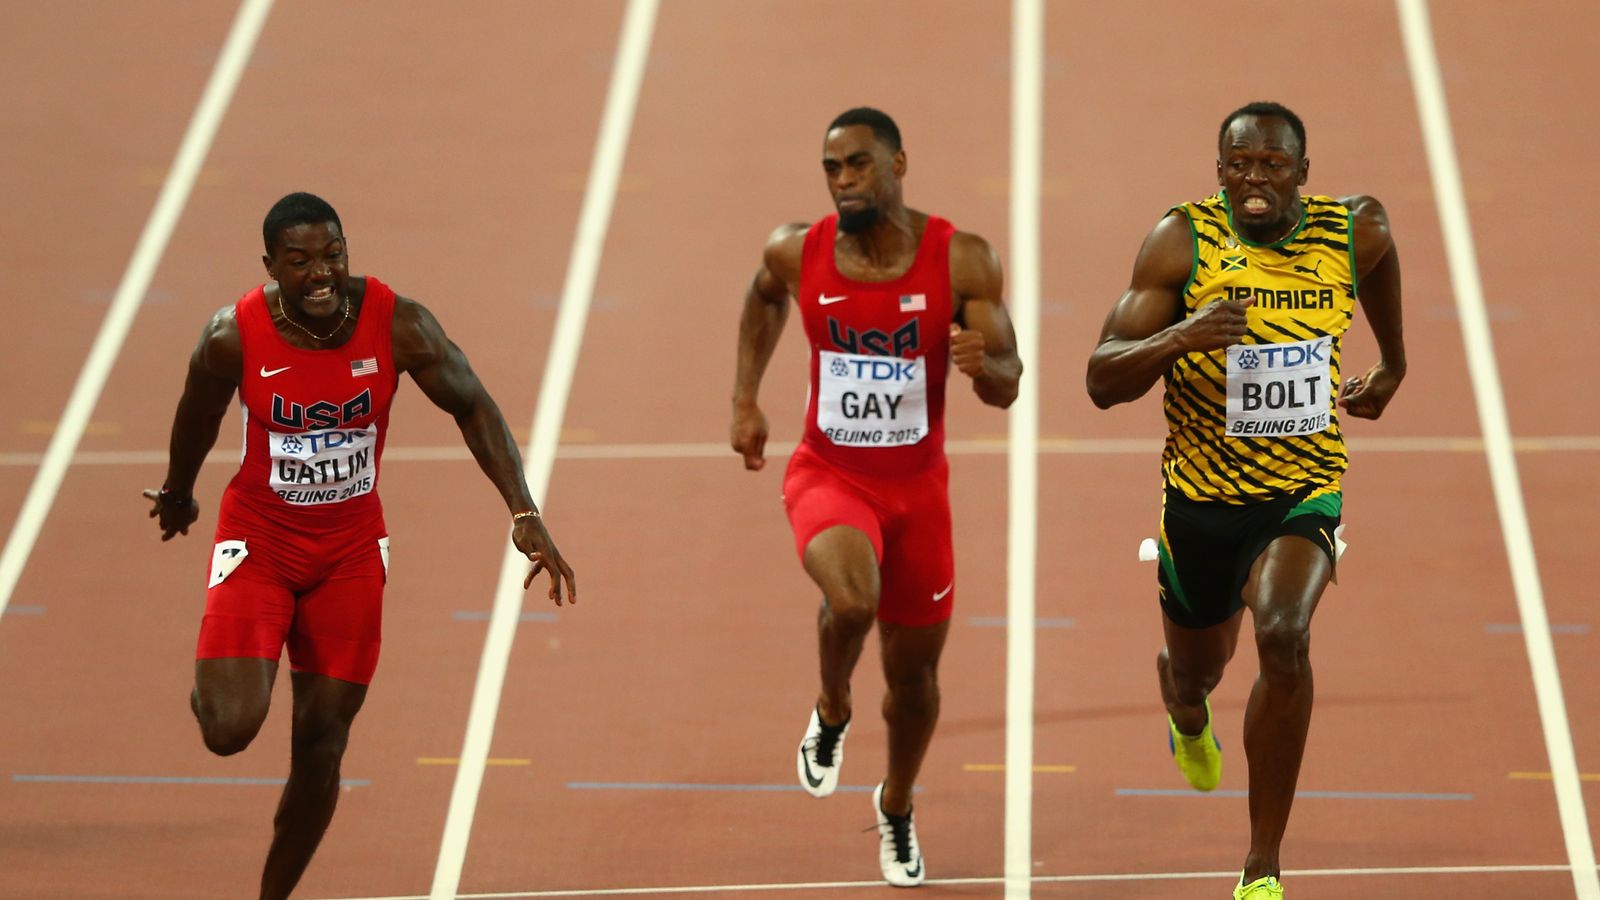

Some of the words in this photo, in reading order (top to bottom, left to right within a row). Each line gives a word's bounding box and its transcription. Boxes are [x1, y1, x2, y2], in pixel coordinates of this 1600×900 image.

[828, 315, 920, 358] USA
[1260, 341, 1324, 367] TDK
[849, 360, 916, 380] TDK
[841, 391, 904, 420] GAY
[1242, 375, 1321, 411] BOLT
[272, 388, 371, 430] USA
[825, 427, 883, 443] BEIJING
[887, 427, 920, 443] 2015
[1232, 419, 1295, 434] BEIJING
[279, 447, 369, 485] GATLIN
[276, 489, 337, 503] BEIJING
[340, 476, 371, 500] 2015
